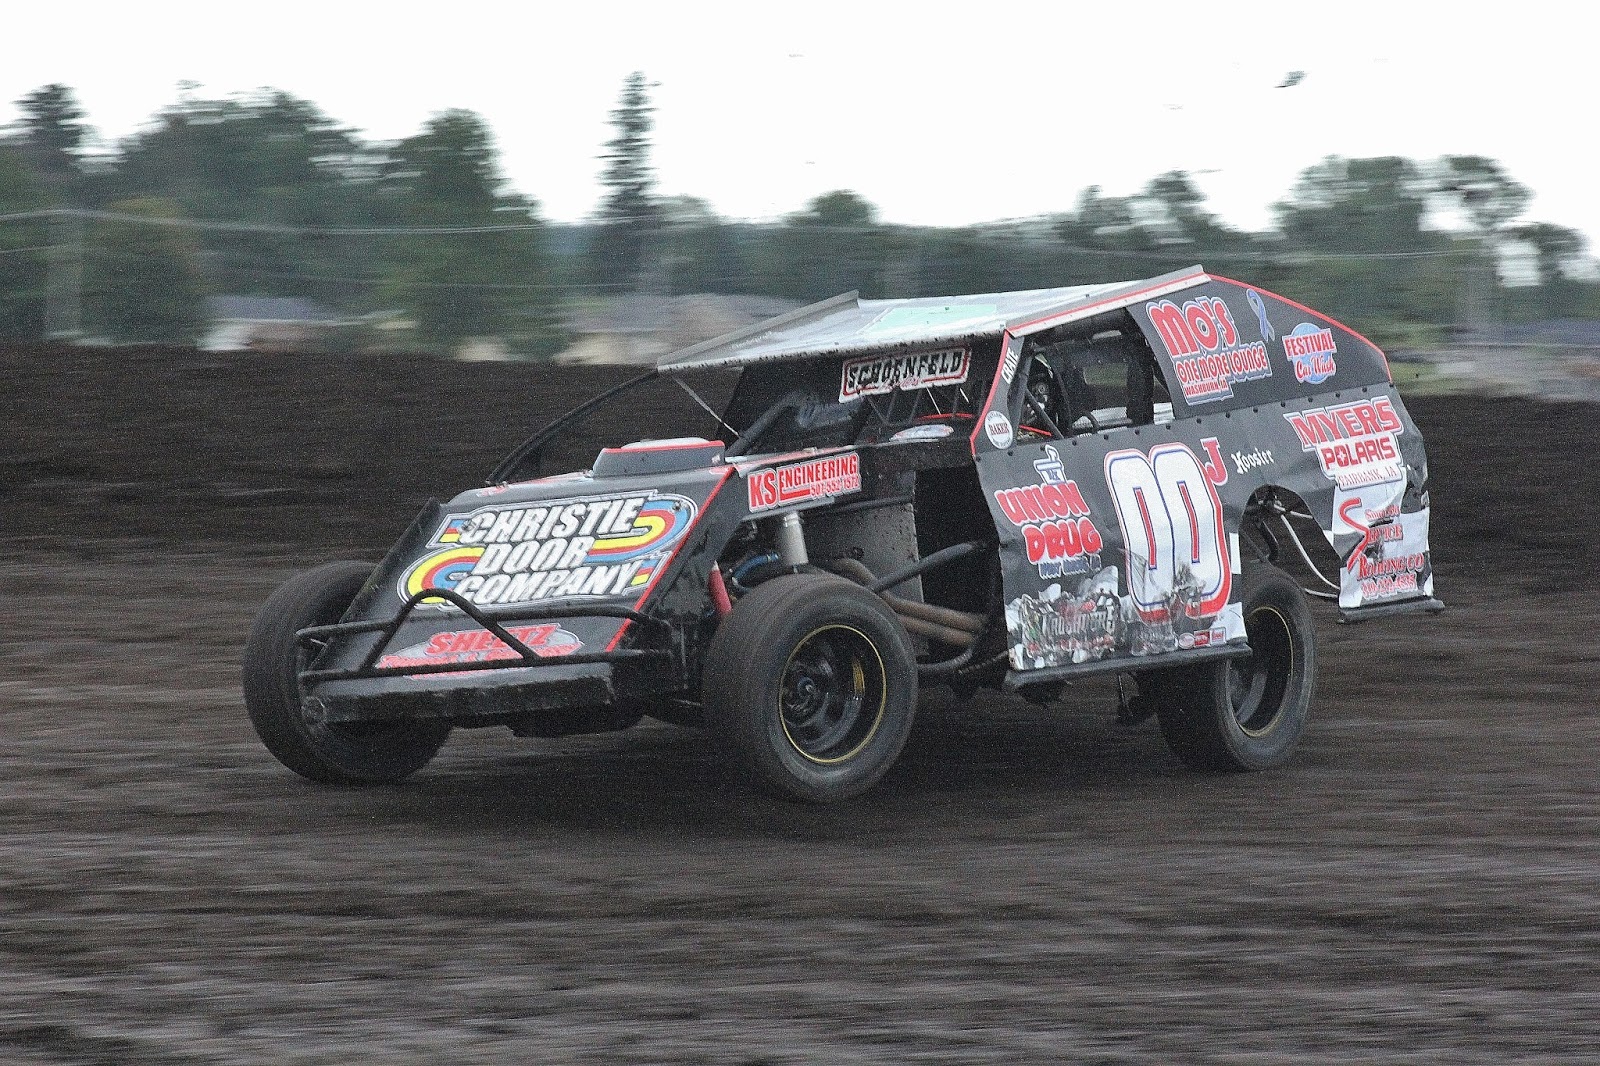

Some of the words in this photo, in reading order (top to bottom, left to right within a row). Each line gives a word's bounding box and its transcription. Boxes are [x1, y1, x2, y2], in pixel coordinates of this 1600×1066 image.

[1150, 301, 1236, 357] MO'S
[1284, 329, 1336, 357] FESTIVAL
[1001, 347, 1018, 385] CRATE
[1176, 360, 1201, 383] ONE
[1198, 354, 1231, 380] MORE
[1229, 345, 1268, 374] LOUNGE
[1295, 361, 1312, 380] Car
[1312, 355, 1336, 375] Wash
[1291, 400, 1402, 447] MYERS
[1231, 447, 1275, 475] Hoosier
[1321, 437, 1397, 470] POLARIS
[1386, 467, 1398, 478] IA
[749, 471, 777, 508] KS
[778, 454, 858, 490] ENGINEERING
[459, 497, 648, 545] CHRISTIE
[995, 480, 1090, 525] UNION
[472, 535, 595, 576] DOOR
[1022, 517, 1103, 564] DRUG
[452, 559, 642, 604] COMPANY
